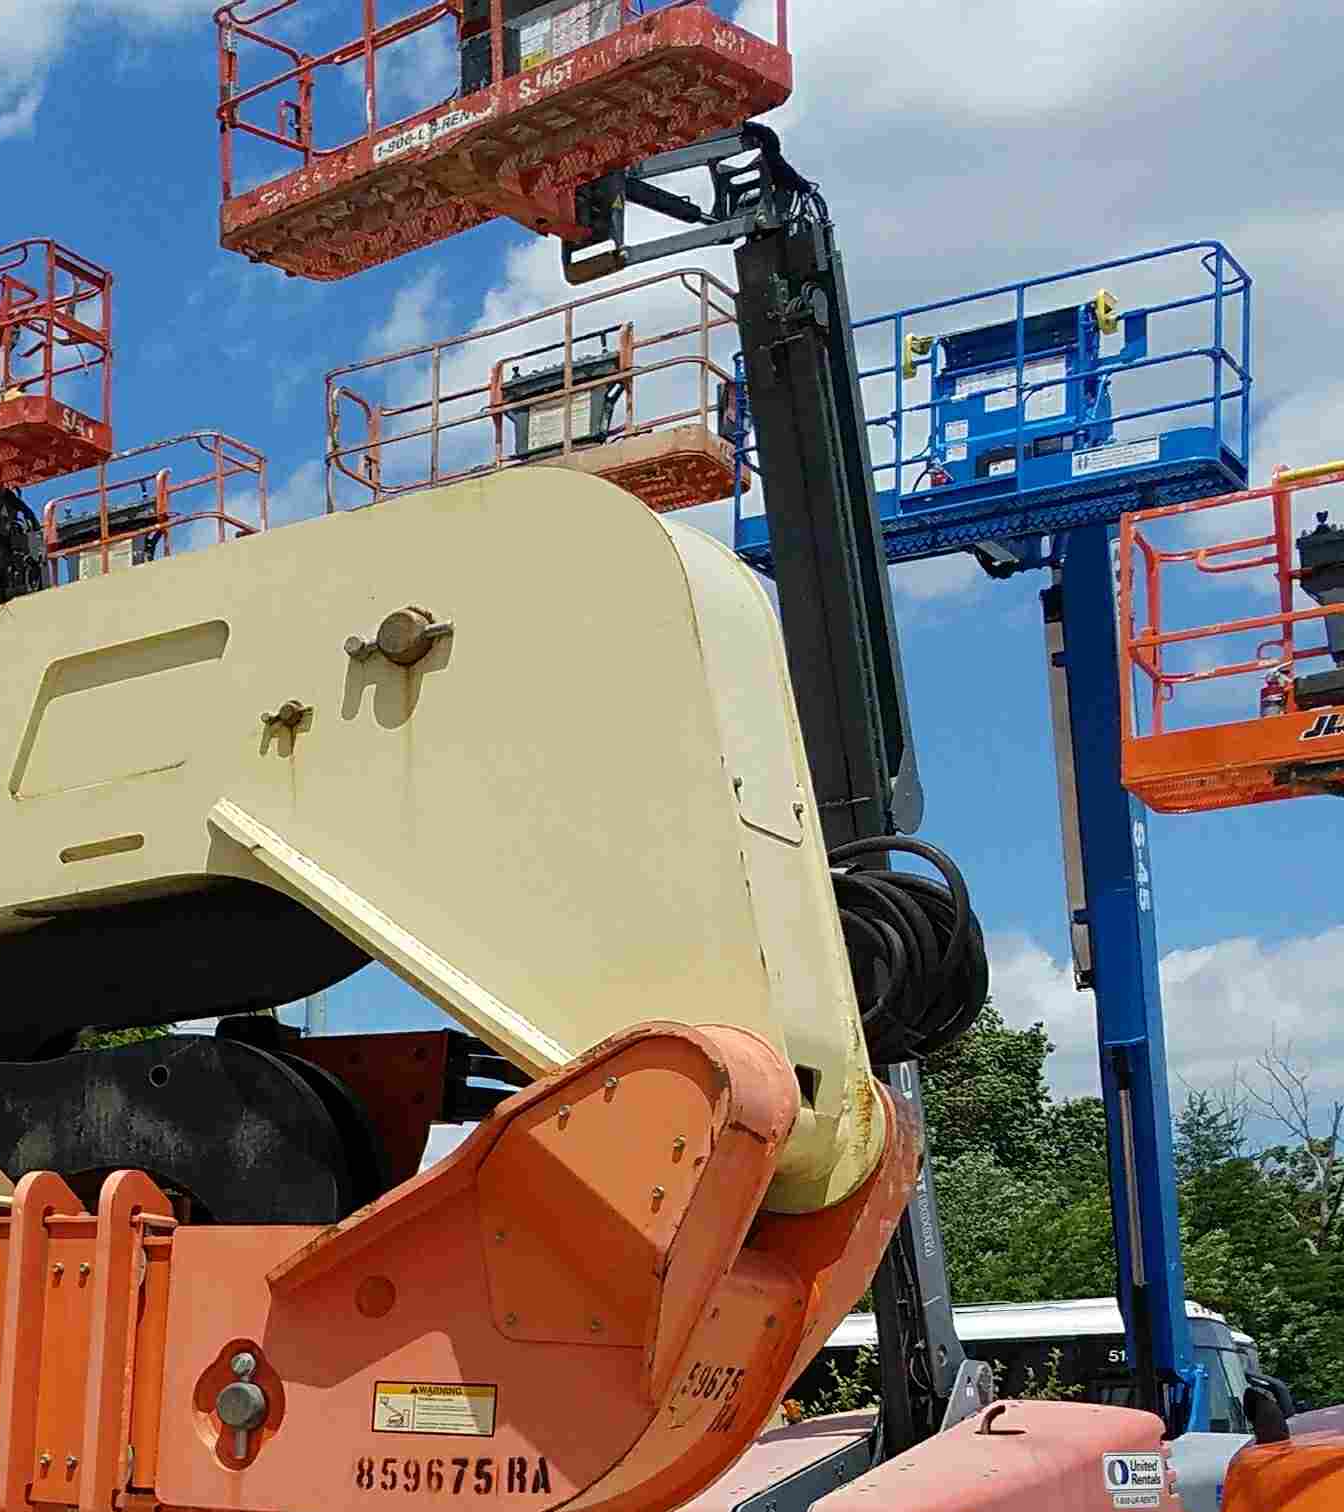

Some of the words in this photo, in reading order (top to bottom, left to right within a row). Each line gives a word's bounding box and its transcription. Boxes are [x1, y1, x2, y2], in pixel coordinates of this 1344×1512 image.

[418, 1385, 463, 1396] WARNING
[356, 1456, 494, 1495] 859675
[507, 1456, 552, 1495] RA
